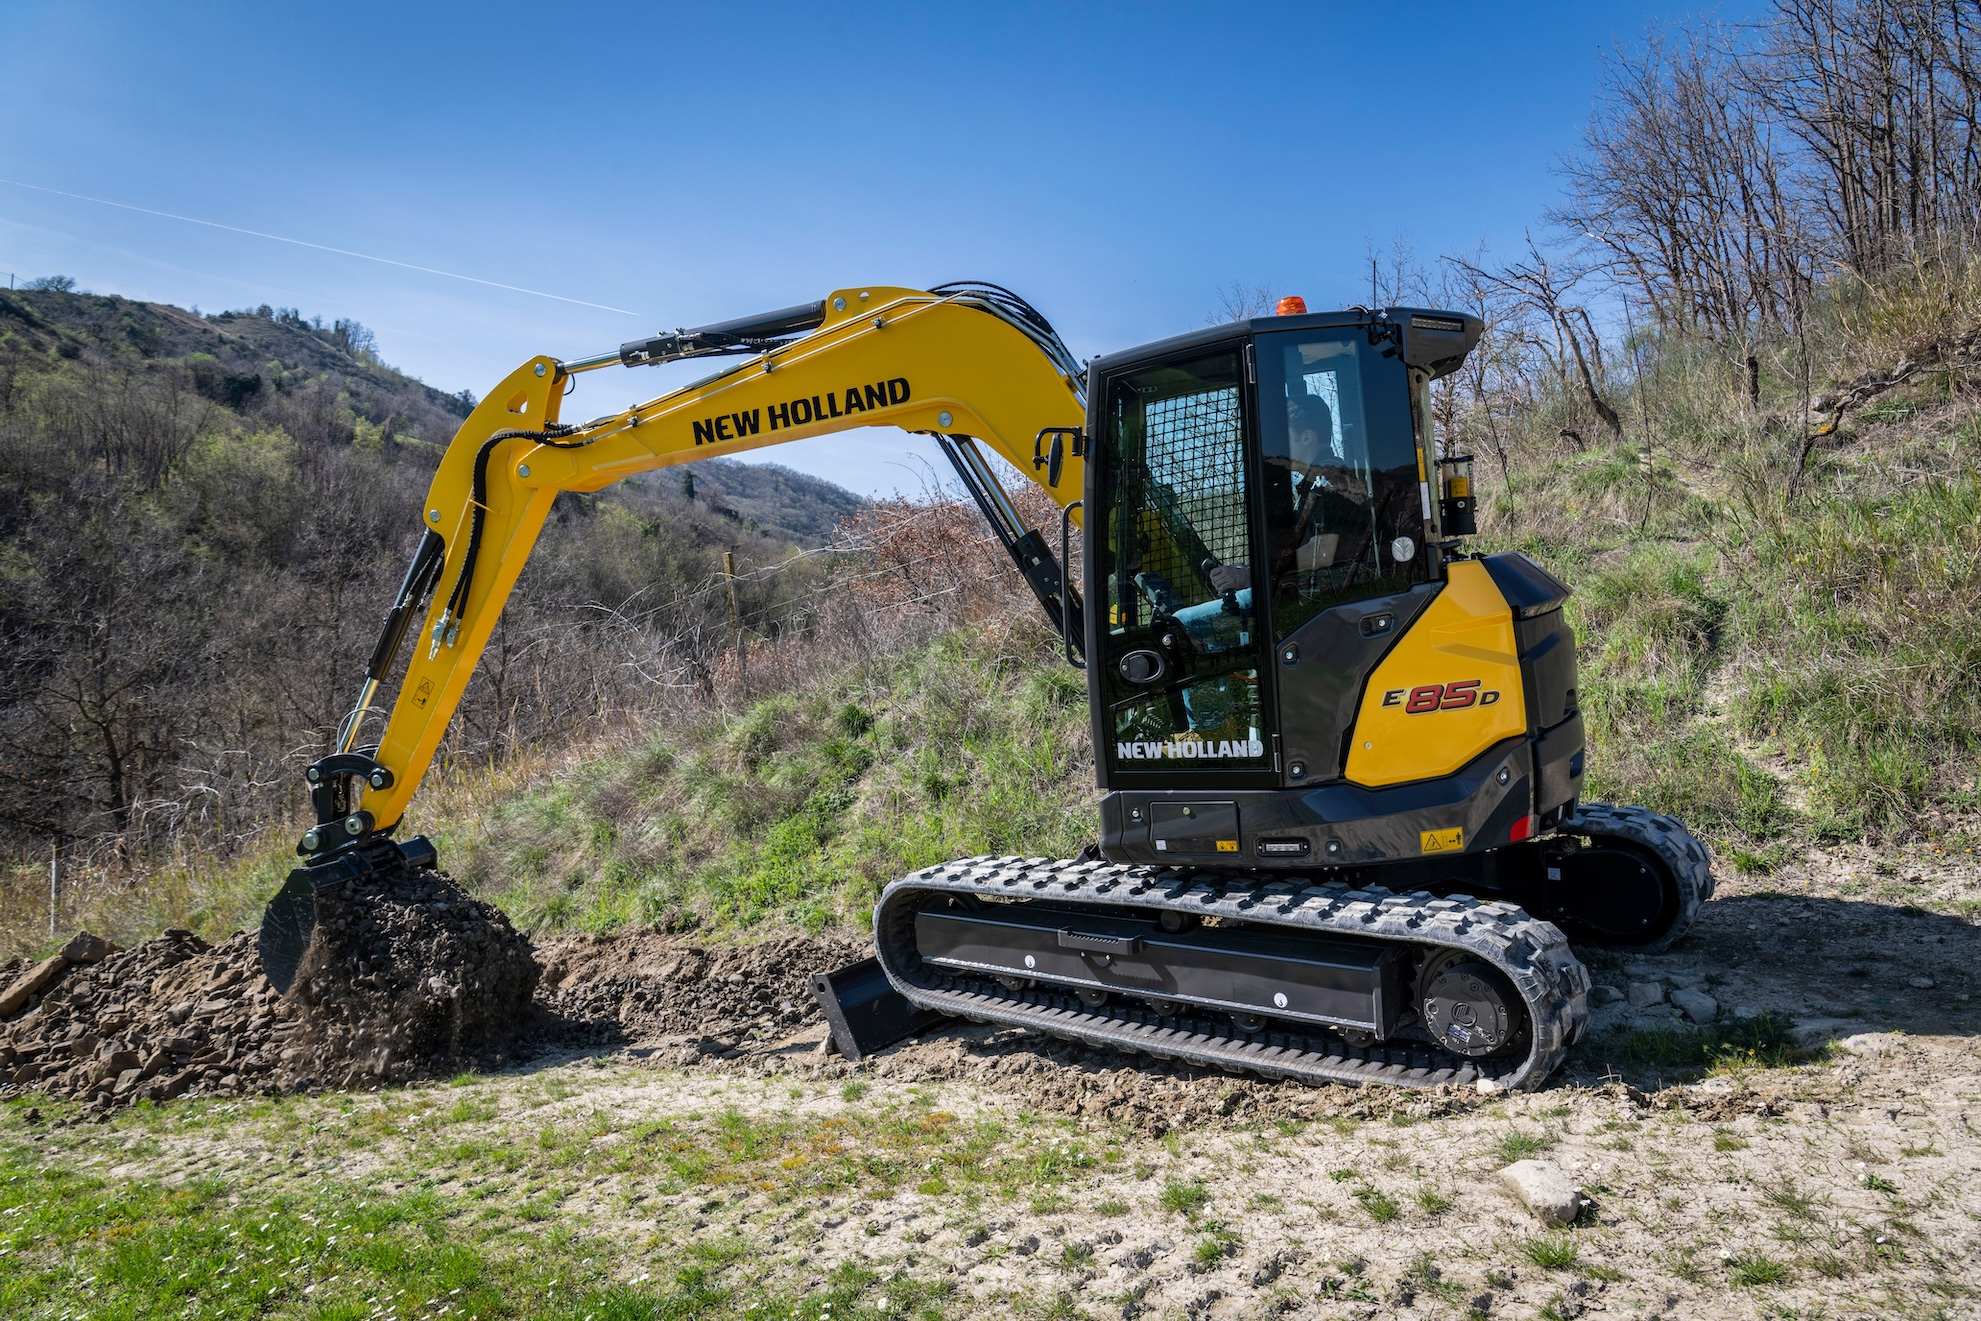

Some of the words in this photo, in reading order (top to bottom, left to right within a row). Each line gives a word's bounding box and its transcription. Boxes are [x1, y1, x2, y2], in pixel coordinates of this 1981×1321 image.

[692, 408, 760, 446] NEW
[767, 377, 911, 430] HOLLAND
[1117, 741, 1163, 759] NEW
[1167, 739, 1264, 759] HOLLAND
